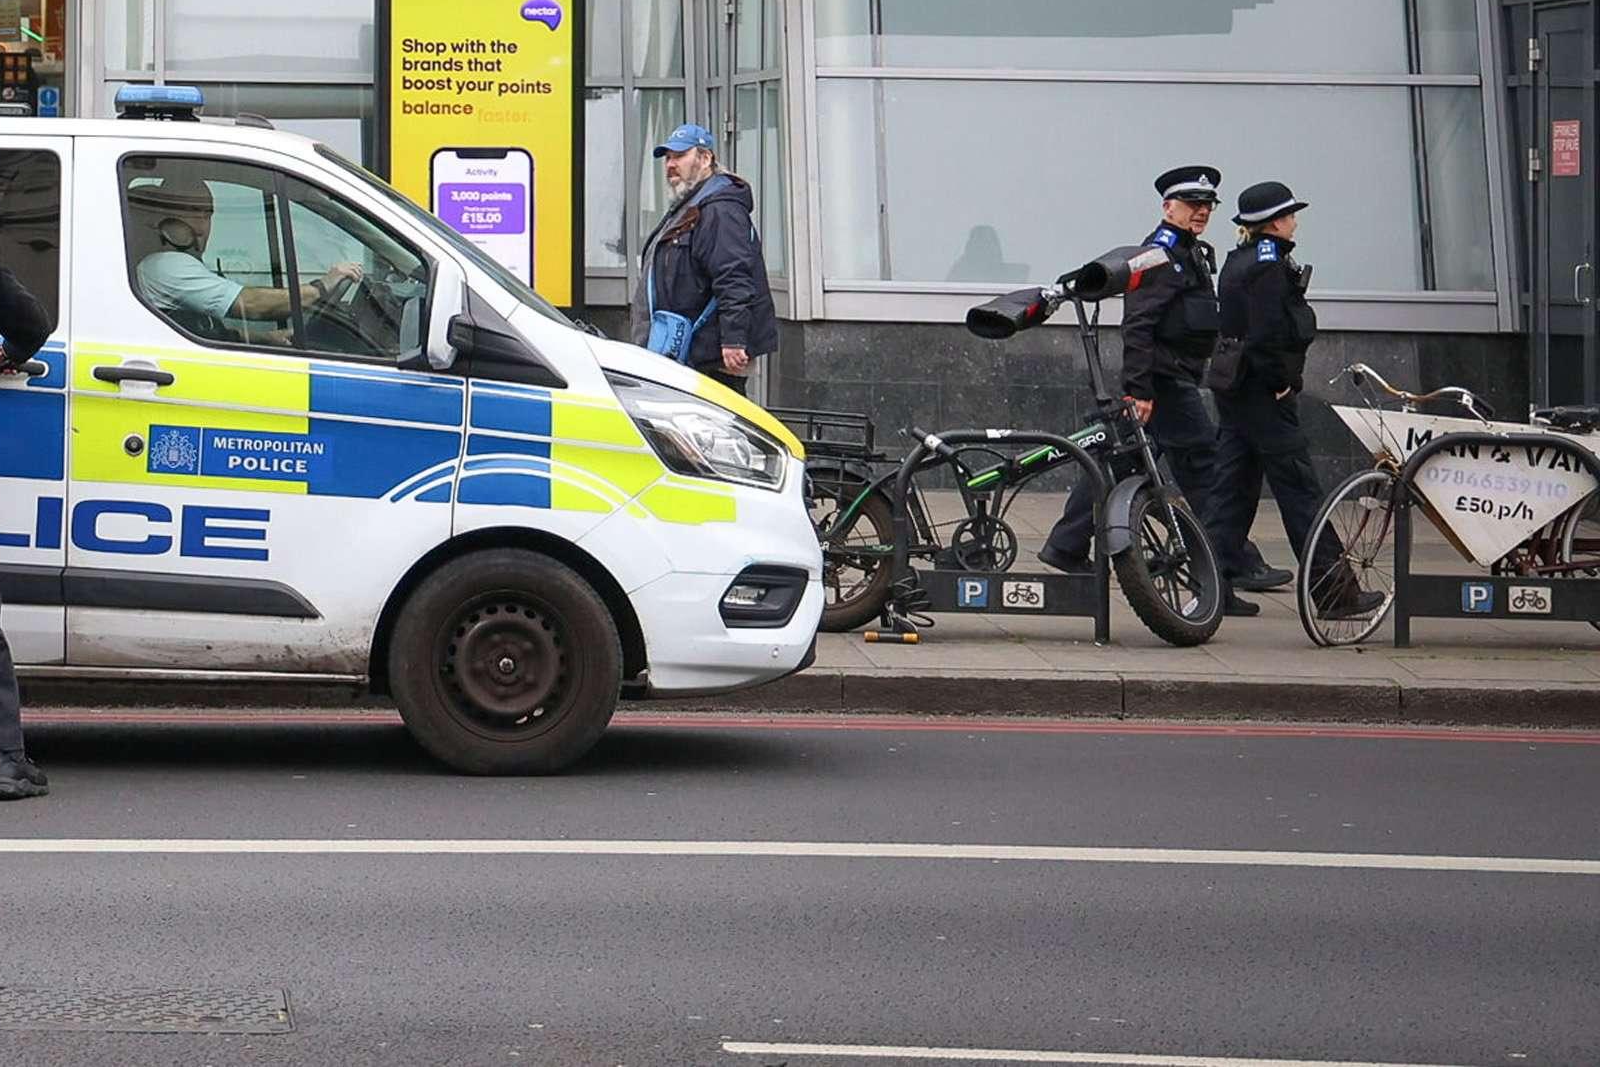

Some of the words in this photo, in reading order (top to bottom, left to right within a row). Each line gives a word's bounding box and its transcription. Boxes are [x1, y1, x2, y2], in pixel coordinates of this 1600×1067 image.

[523, 6, 558, 16] nectar
[402, 38, 446, 56] Shop
[451, 39, 485, 54] with
[490, 40, 518, 54] the
[402, 58, 463, 72] brands
[467, 59, 502, 72] that
[402, 76, 451, 90] boost
[456, 79, 494, 95] your
[498, 81, 552, 96] points
[402, 100, 473, 115] balance
[450, 191, 480, 202] 3,000
[481, 191, 512, 202] points
[461, 212, 503, 224] £15.00
[212, 436, 324, 455] METROPOLITAN
[1046, 431, 1106, 462] ALGRO
[228, 455, 308, 473] POLICE
[965, 581, 983, 604] P
[1469, 586, 1487, 609] P
